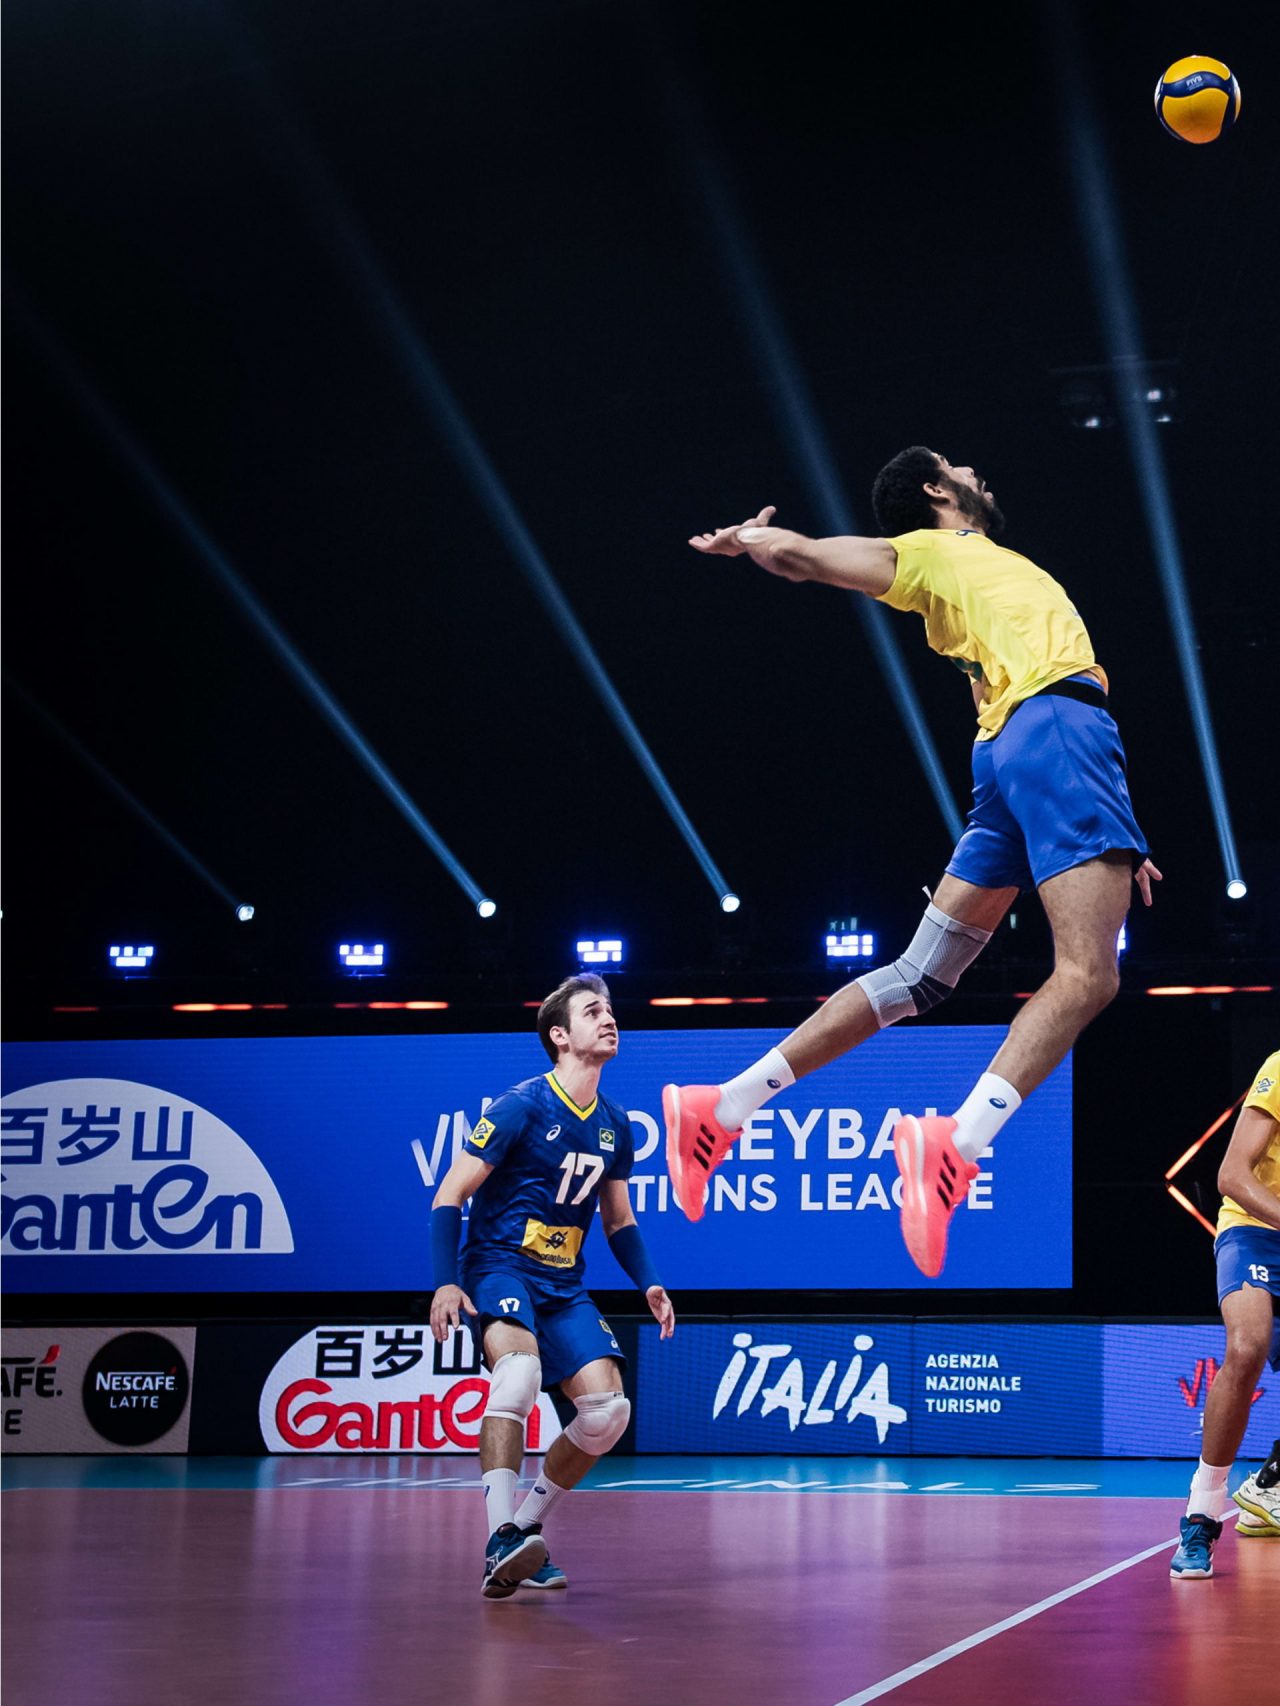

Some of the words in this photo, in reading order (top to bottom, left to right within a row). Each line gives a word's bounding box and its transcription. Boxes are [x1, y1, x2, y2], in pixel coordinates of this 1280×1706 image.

[555, 1152, 605, 1205] 17
[1, 1163, 263, 1251] anten
[1249, 1264, 1270, 1282] 13
[499, 1297, 521, 1314] 17
[314, 1328, 482, 1379] 百岁山
[925, 1354, 999, 1370] AGENZIA
[925, 1376, 1022, 1392] NAZIONALE
[109, 1395, 159, 1409] LATTE
[925, 1398, 1002, 1413] TURISMO
